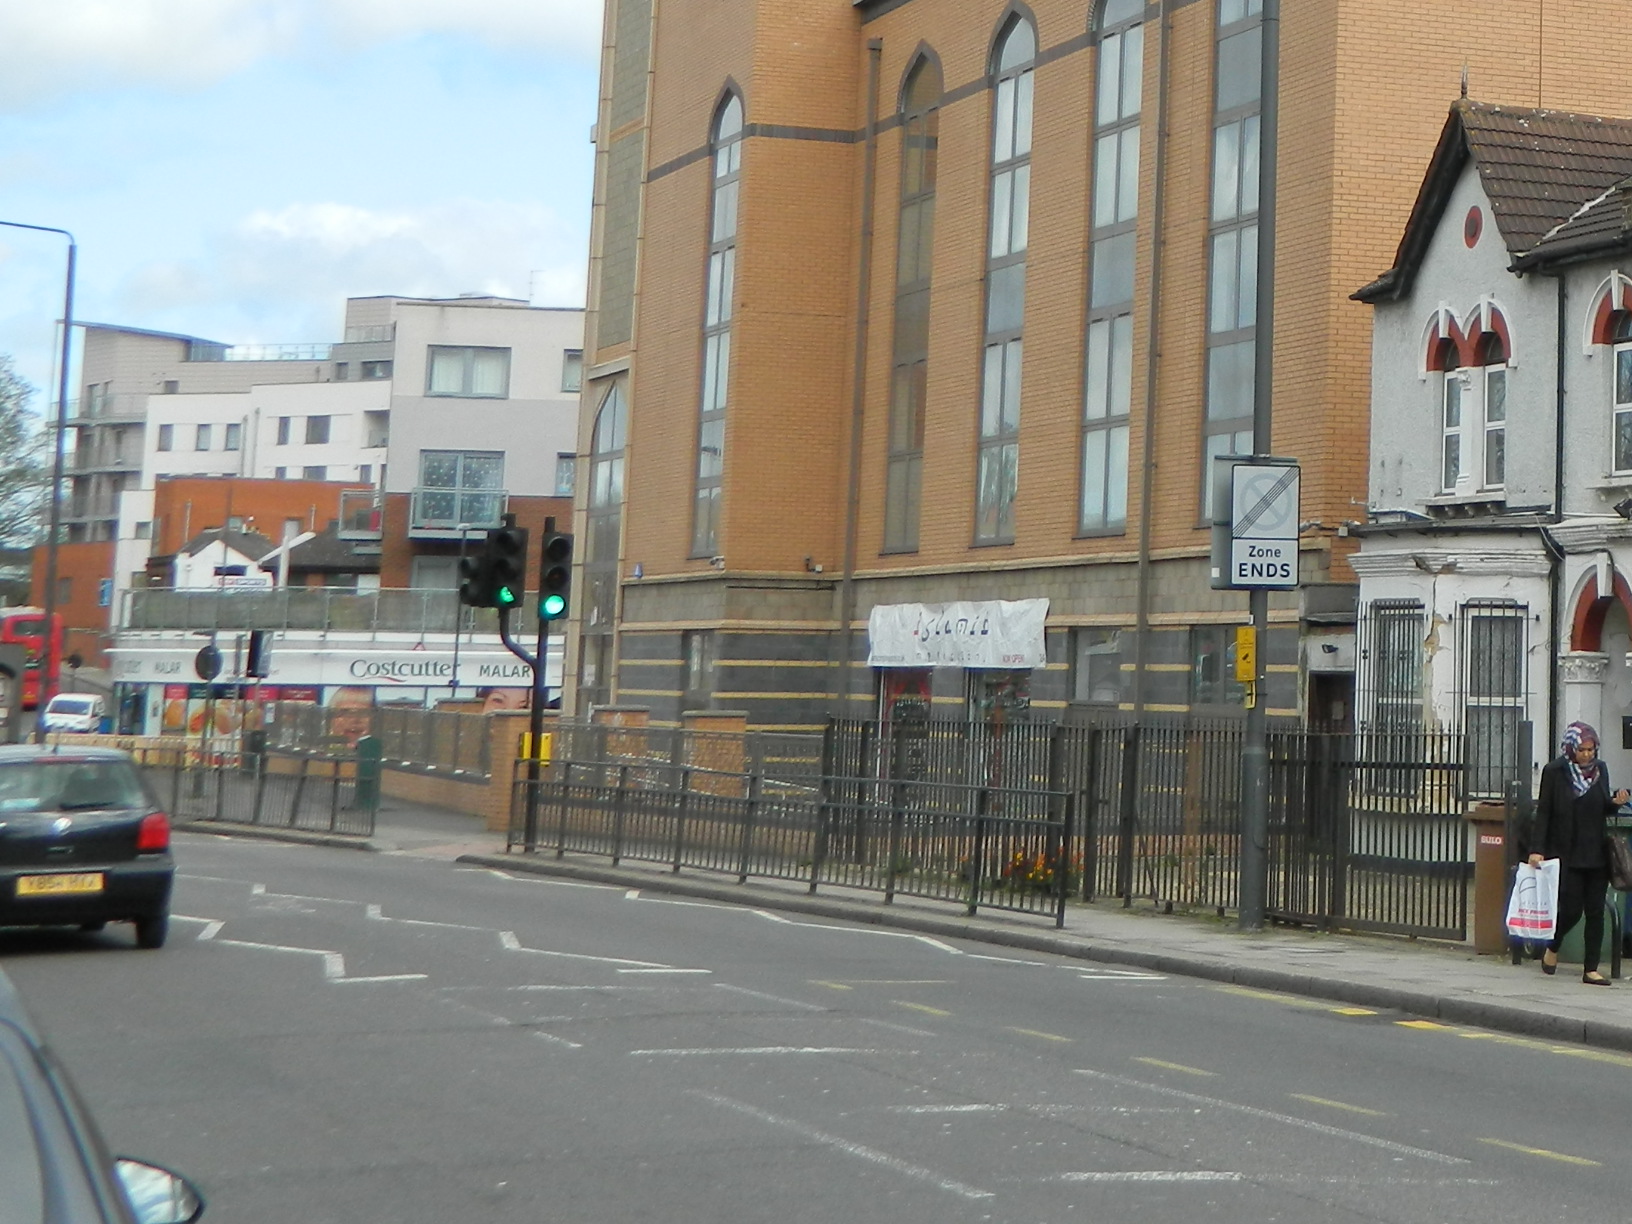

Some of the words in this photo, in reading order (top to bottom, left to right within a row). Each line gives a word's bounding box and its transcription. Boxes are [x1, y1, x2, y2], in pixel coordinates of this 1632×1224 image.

[1248, 545, 1282, 558] Zone
[1238, 562, 1291, 578] ENDS
[350, 659, 461, 676] Costcutter
[479, 664, 530, 678] MALAR
